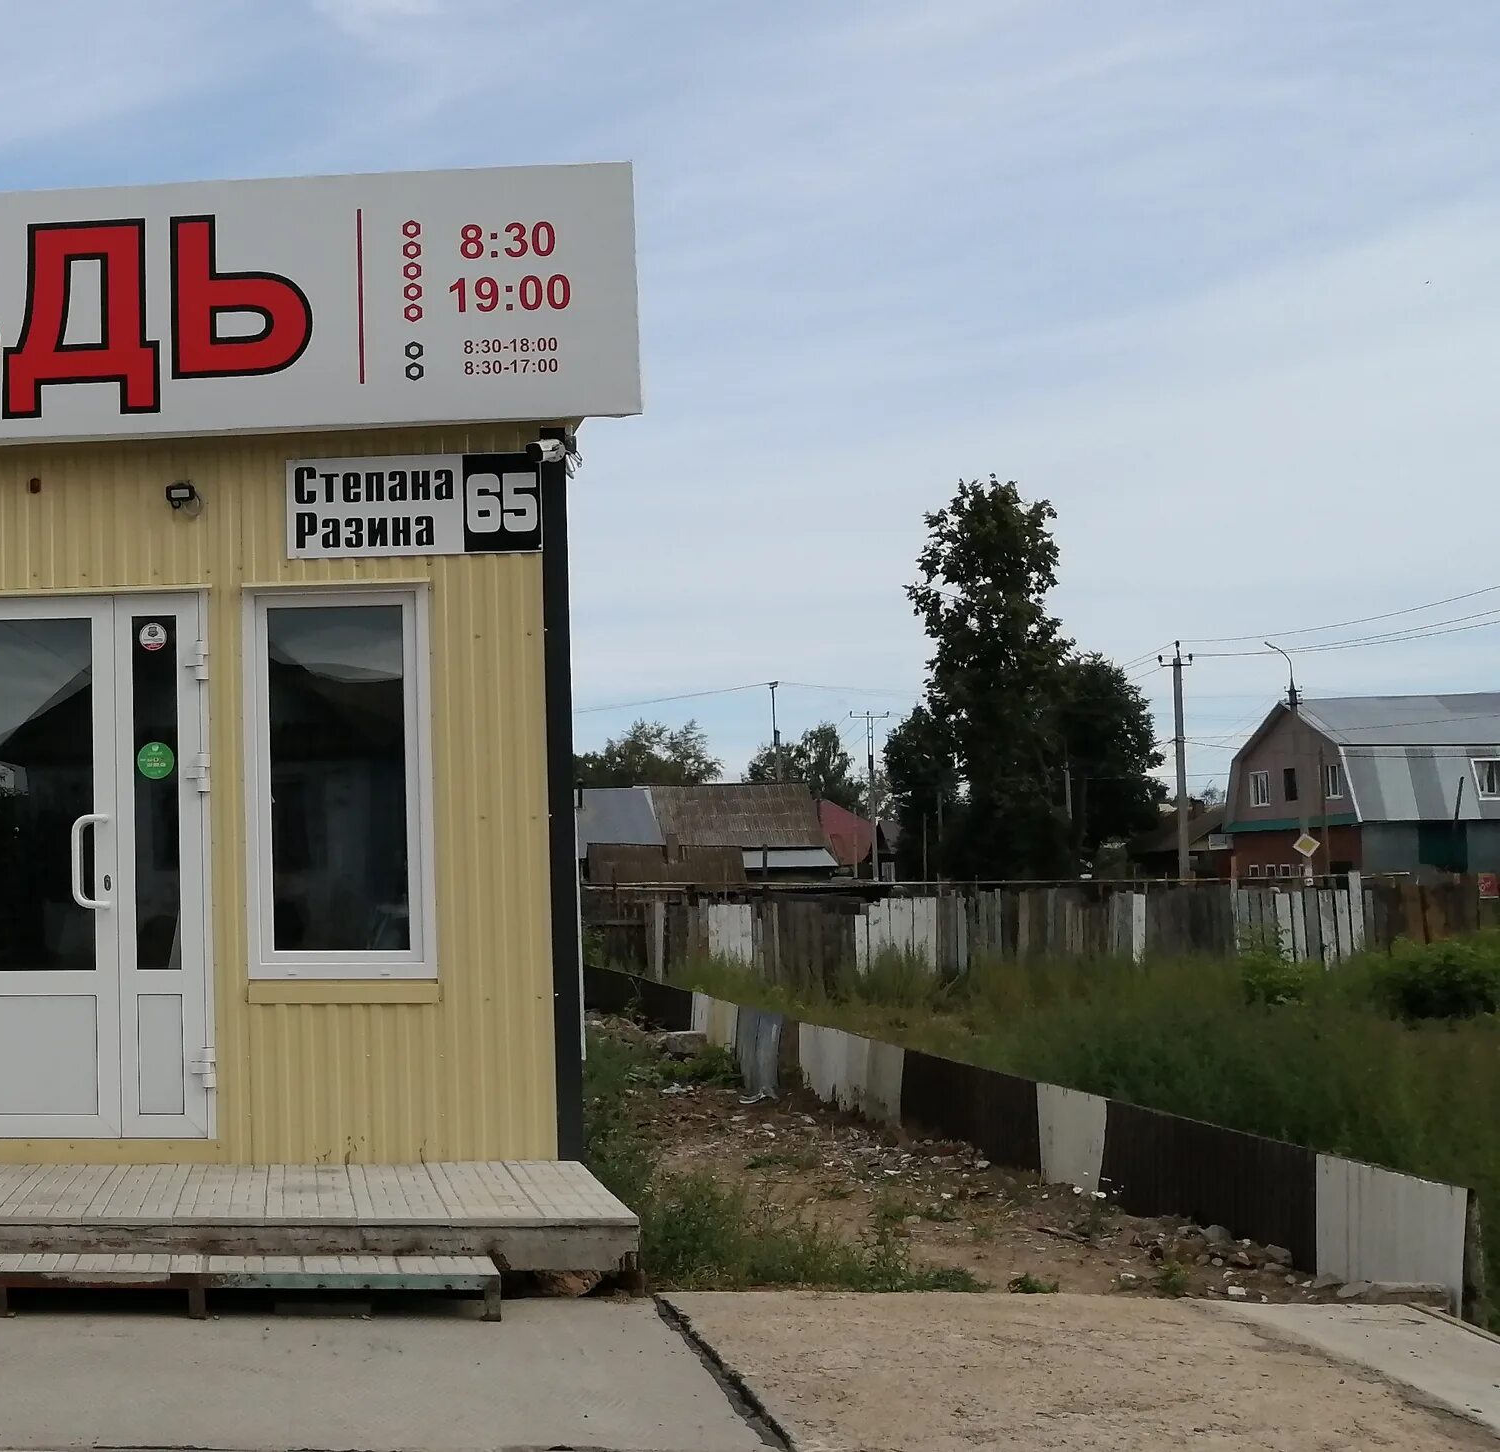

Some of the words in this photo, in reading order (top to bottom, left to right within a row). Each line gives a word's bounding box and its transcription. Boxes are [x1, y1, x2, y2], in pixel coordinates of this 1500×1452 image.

[459, 221, 556, 259] 8:30
[448, 273, 572, 313] 19:00
[463, 336, 558, 355] 8:30-18:00
[463, 357, 559, 376] 8:30-17:00
[294, 466, 454, 504] Степана
[466, 472, 538, 534] 65
[295, 511, 435, 549] Разина
